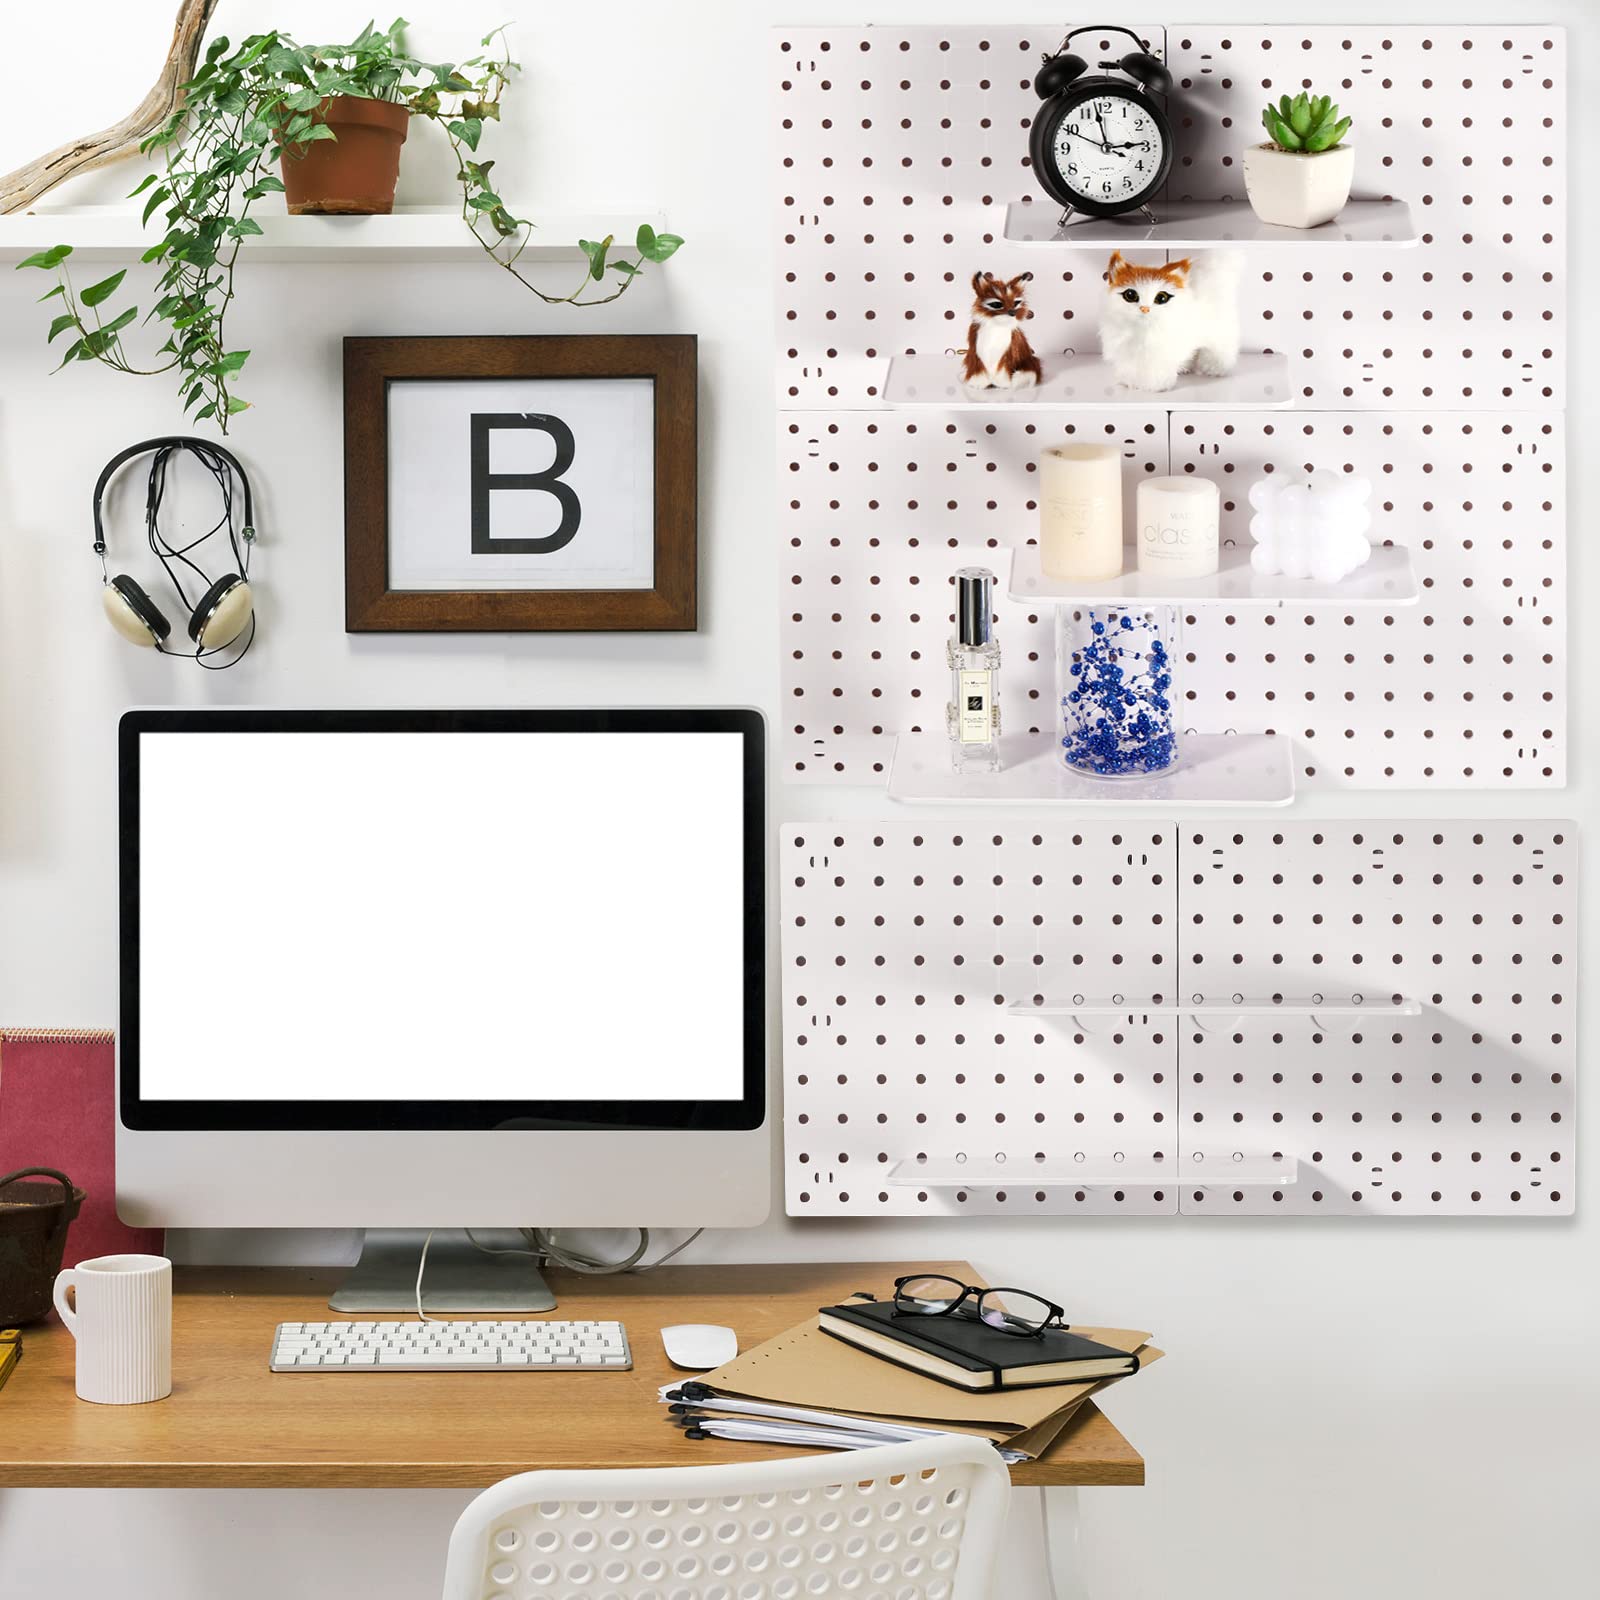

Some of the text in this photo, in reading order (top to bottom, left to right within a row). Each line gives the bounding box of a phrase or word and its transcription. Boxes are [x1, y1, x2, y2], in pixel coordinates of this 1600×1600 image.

[1080, 108, 1090, 119] 11
[1098, 102, 1112, 114] 12
[1122, 107, 1126, 118] 1
[1066, 124, 1079, 135] 10
[1134, 119, 1143, 131] 2
[1061, 142, 1070, 155] 9
[1142, 140, 1150, 152] 3
[1068, 163, 1078, 175] 8
[1135, 160, 1144, 171] 4
[1083, 176, 1091, 188] 7
[1102, 181, 1111, 192] 6
[1123, 176, 1132, 188] 5
[470, 413, 581, 554] B
[1144, 522, 1216, 544] clasc
